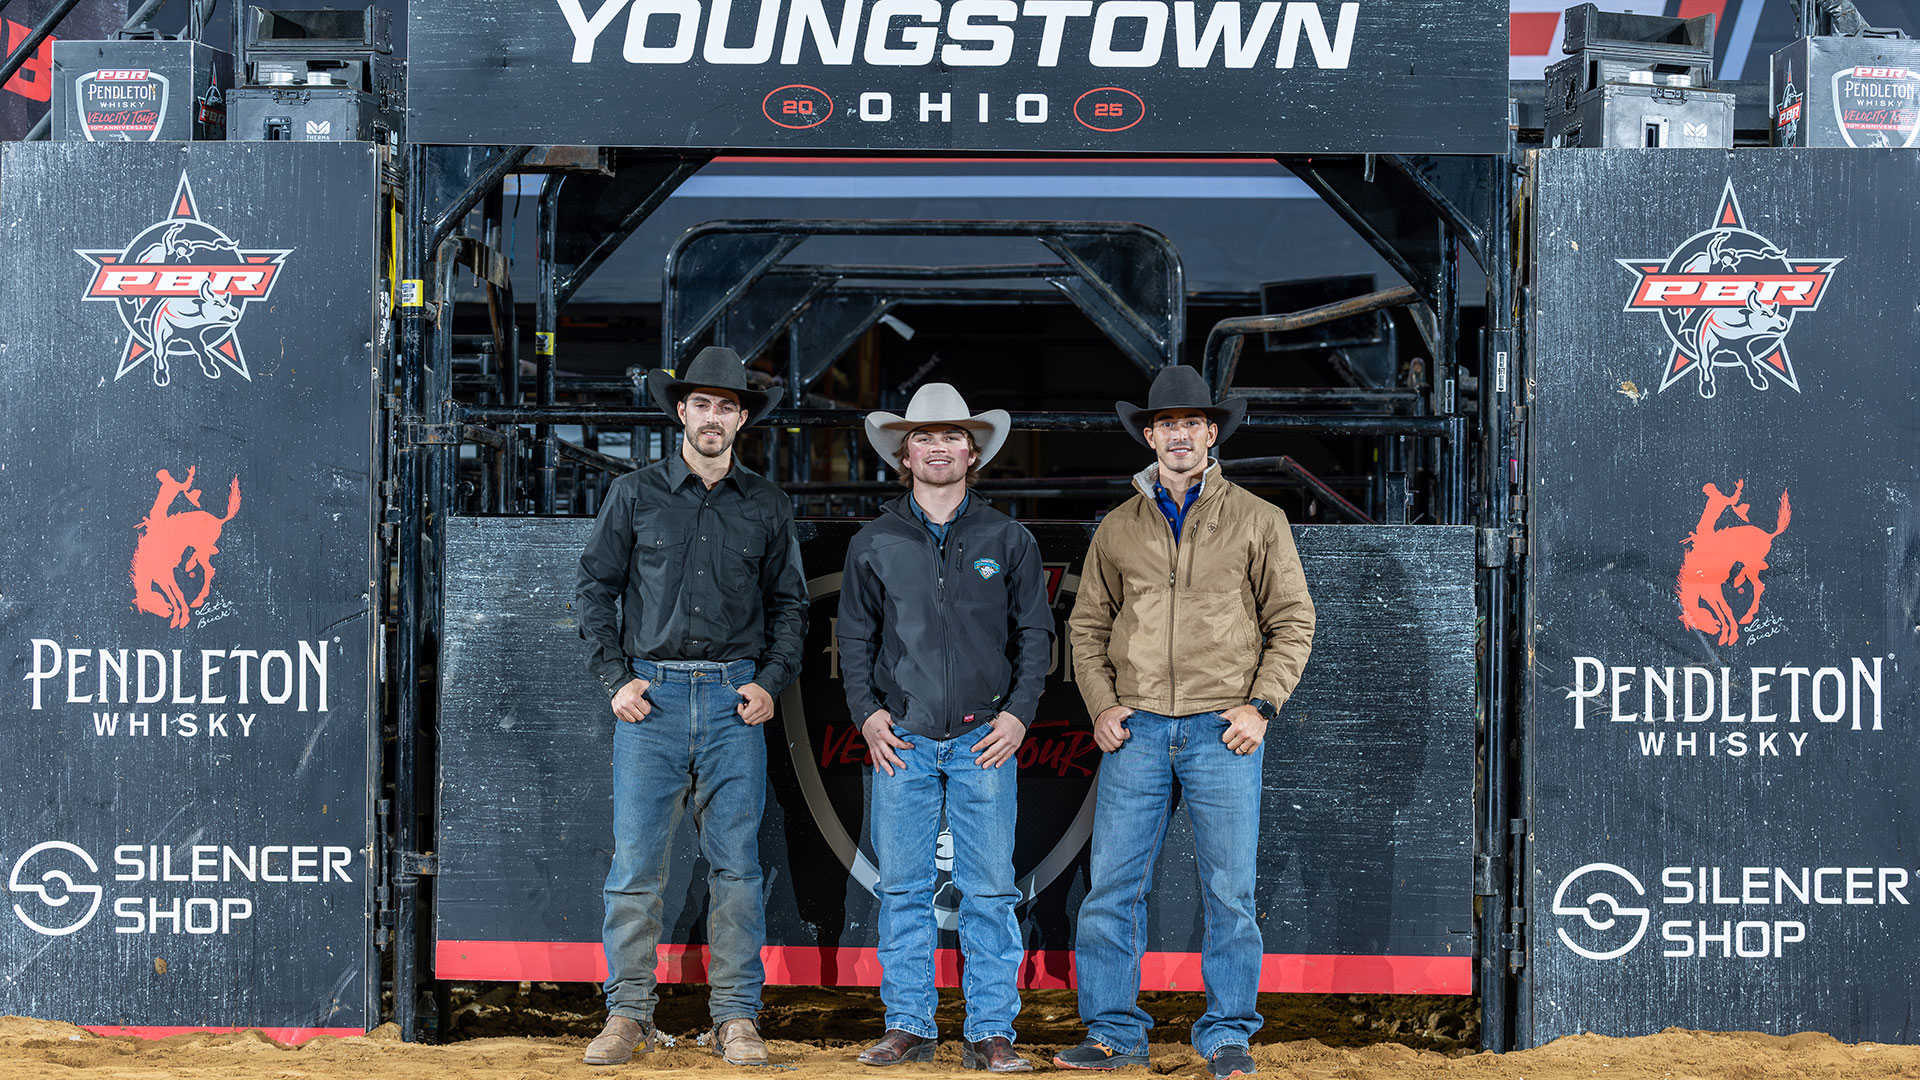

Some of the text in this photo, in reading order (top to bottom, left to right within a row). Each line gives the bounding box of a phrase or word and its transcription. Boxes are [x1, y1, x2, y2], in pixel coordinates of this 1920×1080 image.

[558, 0, 1359, 69] YOUNGSTOWN
[100, 70, 146, 80] PBR
[1856, 67, 1904, 78] PBR
[88, 83, 156, 100] PENDLETON
[1845, 80, 1914, 99] PENDLETON
[783, 92, 1123, 123] 20 OHIO 25
[1779, 105, 1800, 125] PBR
[1857, 99, 1902, 107] WHISKY
[88, 111, 131, 125] VELOCITY
[101, 271, 265, 291] PBR
[1643, 281, 1814, 302] PBR
[23, 638, 329, 712] PENDLETON
[1565, 656, 1883, 731] PENDLETON
[93, 713, 257, 737] WHISKY
[1638, 731, 1809, 757] WHISKY
[114, 844, 353, 883] SILENCER
[1662, 866, 1910, 905] SILENCER
[114, 897, 252, 934] SHOP
[1662, 920, 1806, 958] SHOP
